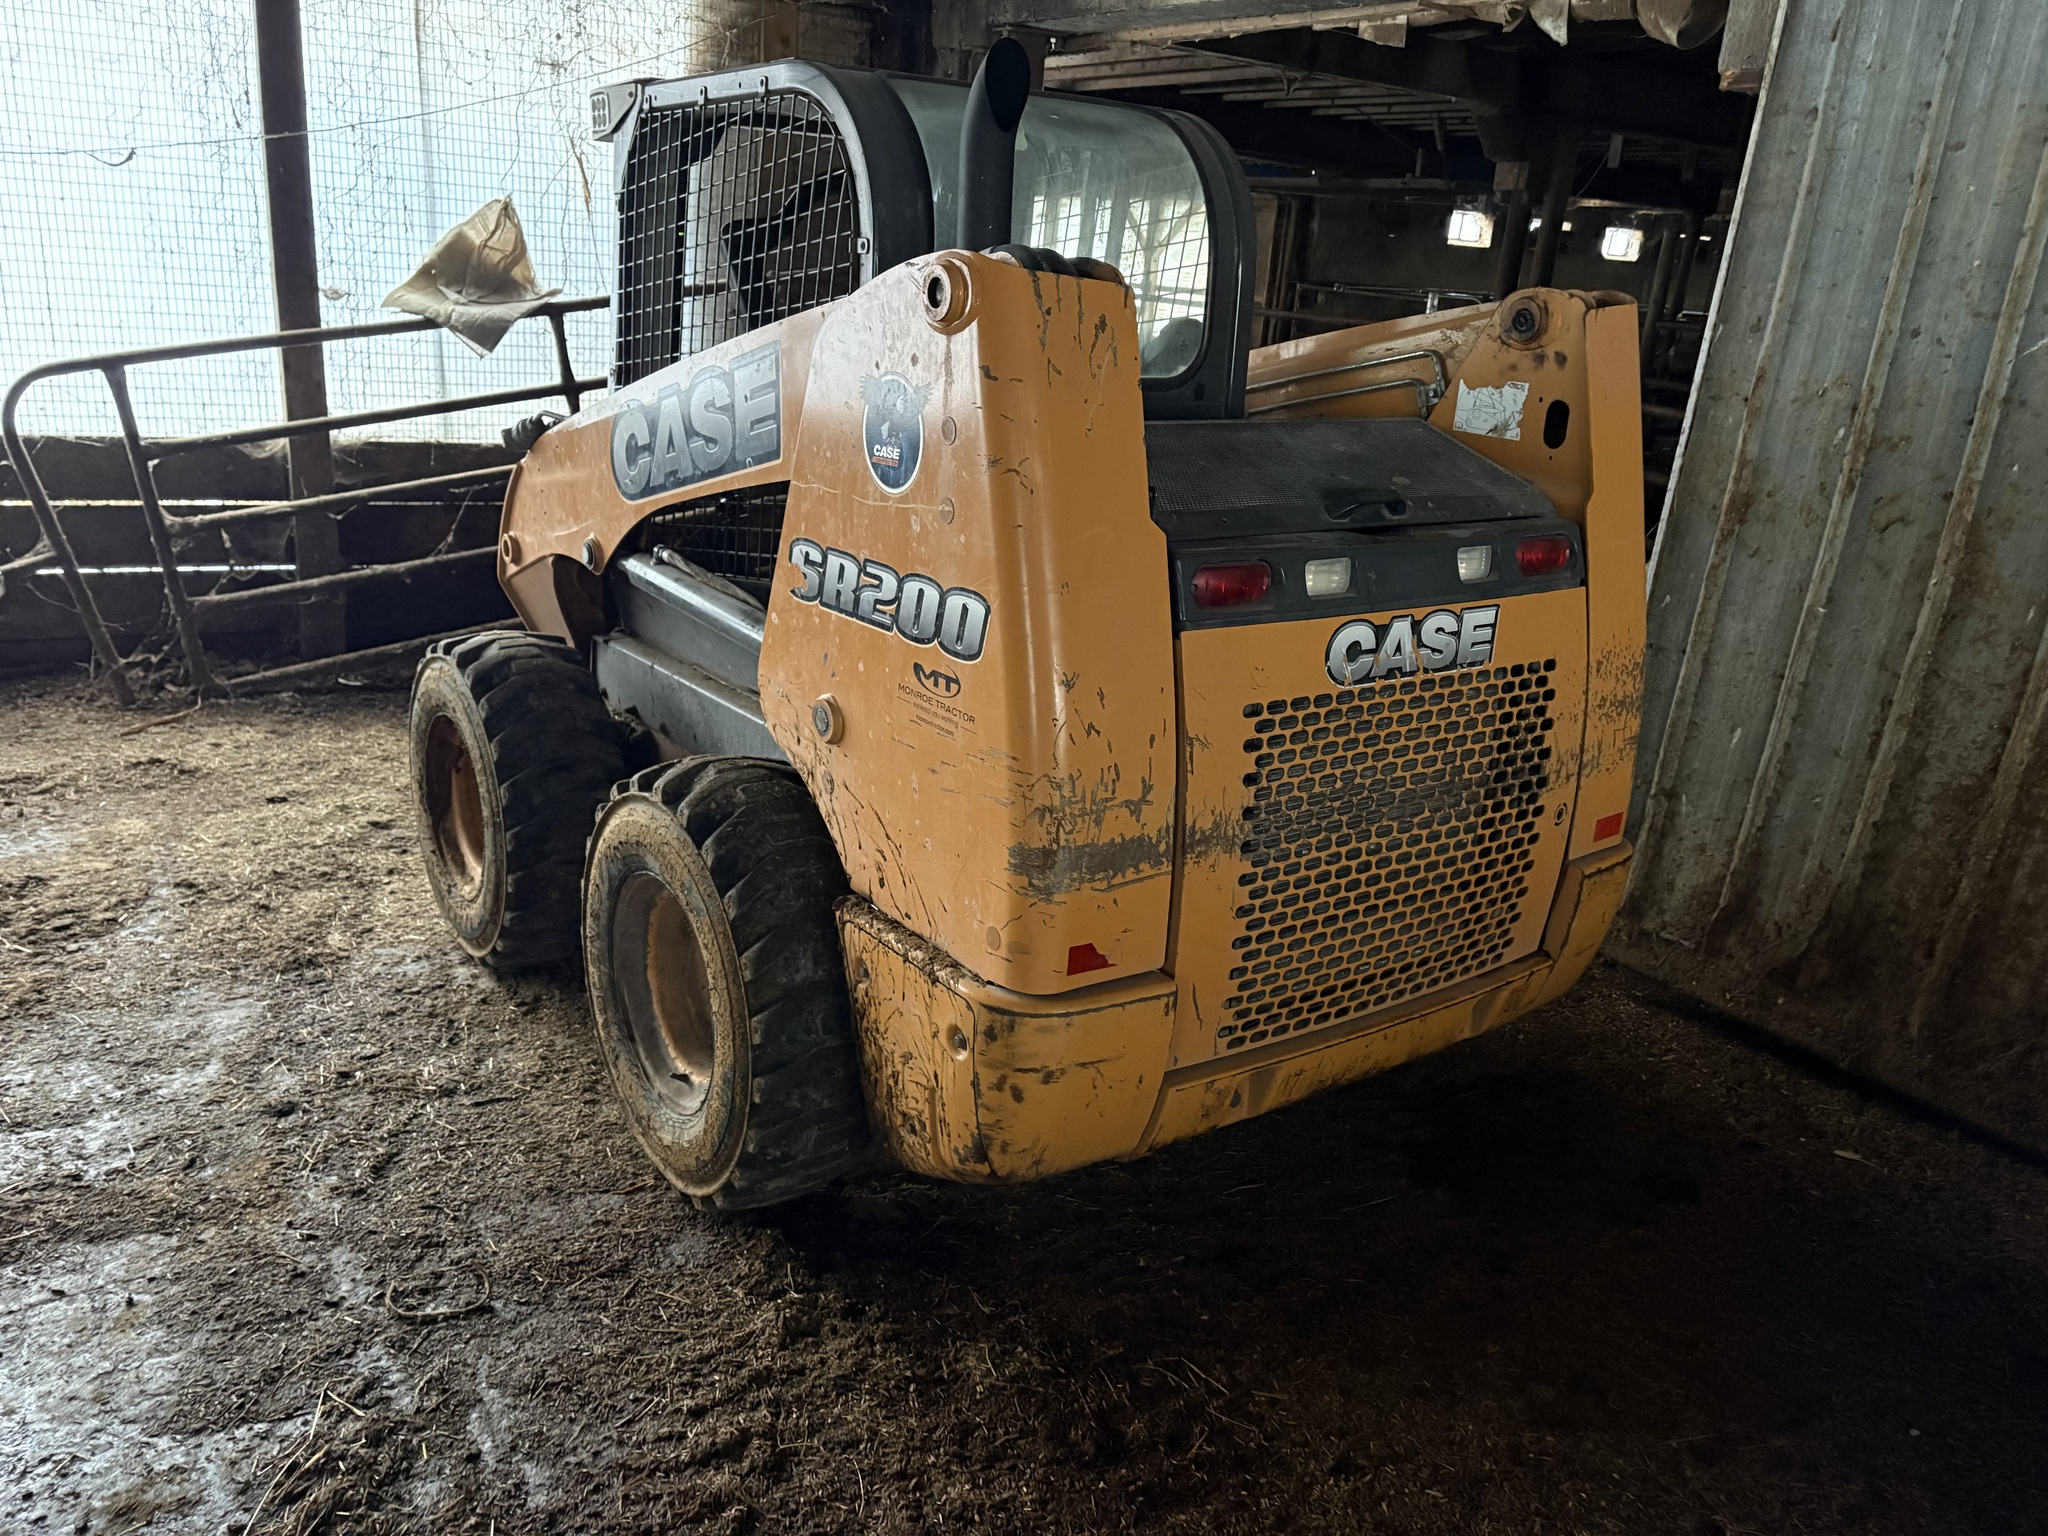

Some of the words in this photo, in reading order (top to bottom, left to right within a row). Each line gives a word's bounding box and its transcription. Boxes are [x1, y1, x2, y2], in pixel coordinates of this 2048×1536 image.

[612, 346, 780, 498] CASE
[873, 444, 901, 460] CASE
[789, 537, 991, 663] SR200
[1325, 604, 1500, 688] CASE
[898, 683, 934, 706] MONROE
[935, 699, 976, 725] TRACTOR
